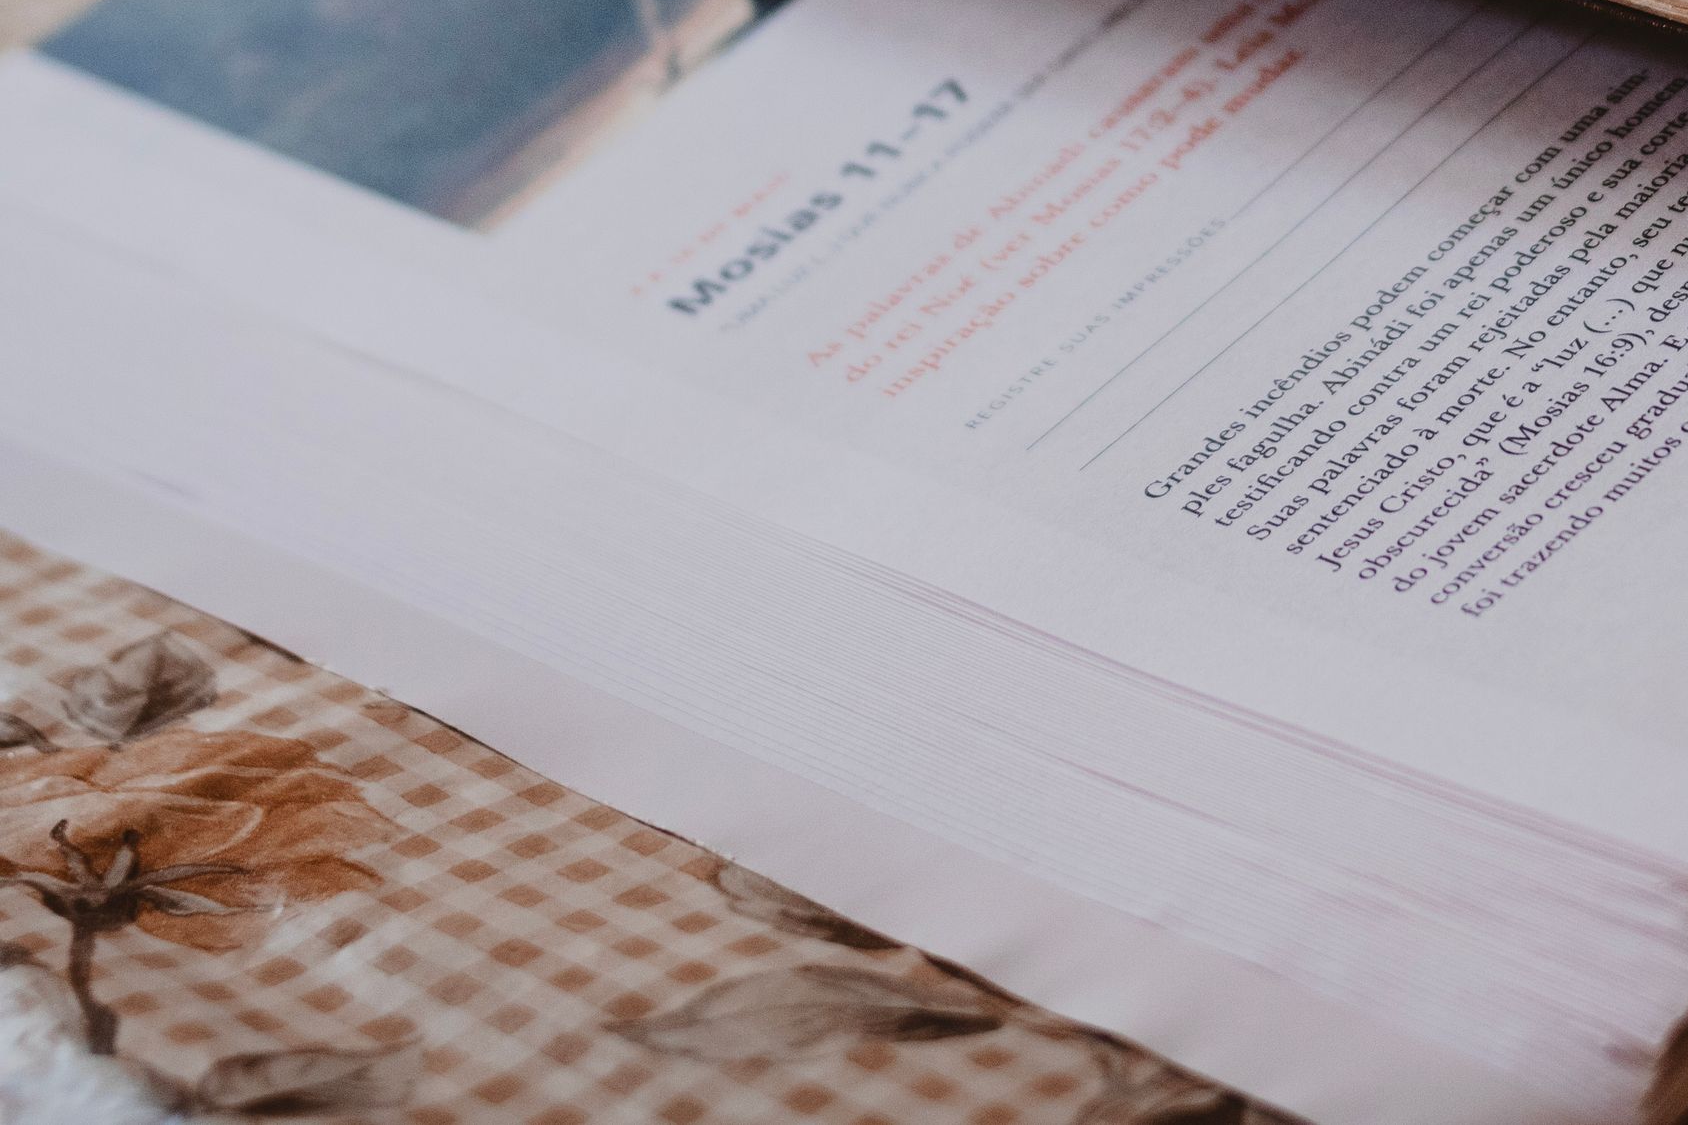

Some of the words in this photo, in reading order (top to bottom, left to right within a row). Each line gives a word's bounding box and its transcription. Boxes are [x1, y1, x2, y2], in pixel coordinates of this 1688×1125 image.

[667, 193, 843, 318] Mosias
[882, 292, 1016, 397] inspiração
[1018, 233, 1086, 288] sobre
[1090, 172, 1158, 228] como
[1144, 420, 1247, 499] Grandes
[1239, 330, 1352, 418] incêndios
[1350, 262, 1429, 332] podem
[1427, 186, 1515, 264] começar
[1514, 144, 1563, 184] com
[1560, 104, 1610, 143] uma
[1631, 256, 1675, 295] que
[808, 341, 843, 367] As
[846, 354, 882, 385] do
[964, 356, 1058, 429] REGISTRE
[1060, 314, 1110, 353] SUAS
[1180, 474, 1233, 518] ples
[1227, 400, 1324, 472] fagulha.
[1321, 319, 1413, 395] Abinádi
[1406, 290, 1446, 319] foi
[1444, 226, 1519, 291] apenas
[1516, 193, 1556, 224] um
[1551, 139, 1614, 191] único
[1214, 419, 1347, 528] testificando
[1347, 357, 1421, 417] contra
[1420, 321, 1460, 353] um
[1457, 292, 1491, 320] rei
[1489, 205, 1588, 294] poderoso
[1587, 191, 1605, 203] e
[1602, 157, 1642, 189] sua
[1247, 495, 1310, 541] Suas
[1308, 414, 1403, 495] palavras
[1396, 356, 1472, 412] foram
[1468, 263, 1572, 353] rejeitadas
[1569, 221, 1619, 265] pela
[1286, 443, 1419, 555] sentenciado
[1417, 425, 1439, 441] à
[1437, 364, 1512, 426] morte.
[1501, 328, 1547, 360] No
[1546, 253, 1639, 328] entanto,
[1632, 217, 1672, 249] seu
[1522, 380, 1542, 394] a
[1531, 337, 1589, 374] “luz
[1358, 457, 1494, 581] obscurecida”
[1498, 379, 1590, 456] (Mosias
[1584, 329, 1655, 377] 16:9),
[1462, 410, 1507, 449] que
[1502, 393, 1524, 409] é
[1379, 453, 1468, 515] Cristo,
[1393, 566, 1429, 593] do
[1422, 506, 1501, 569] jovem
[1499, 413, 1605, 505] sacerdote
[1600, 358, 1669, 413] Alma.
[1430, 512, 1544, 606] conversão
[1544, 440, 1628, 510] cresceu
[1460, 588, 1504, 619] foi
[1501, 504, 1604, 589] trazendo
[1602, 434, 1682, 504] muitos
[1315, 516, 1385, 572] Jesus
